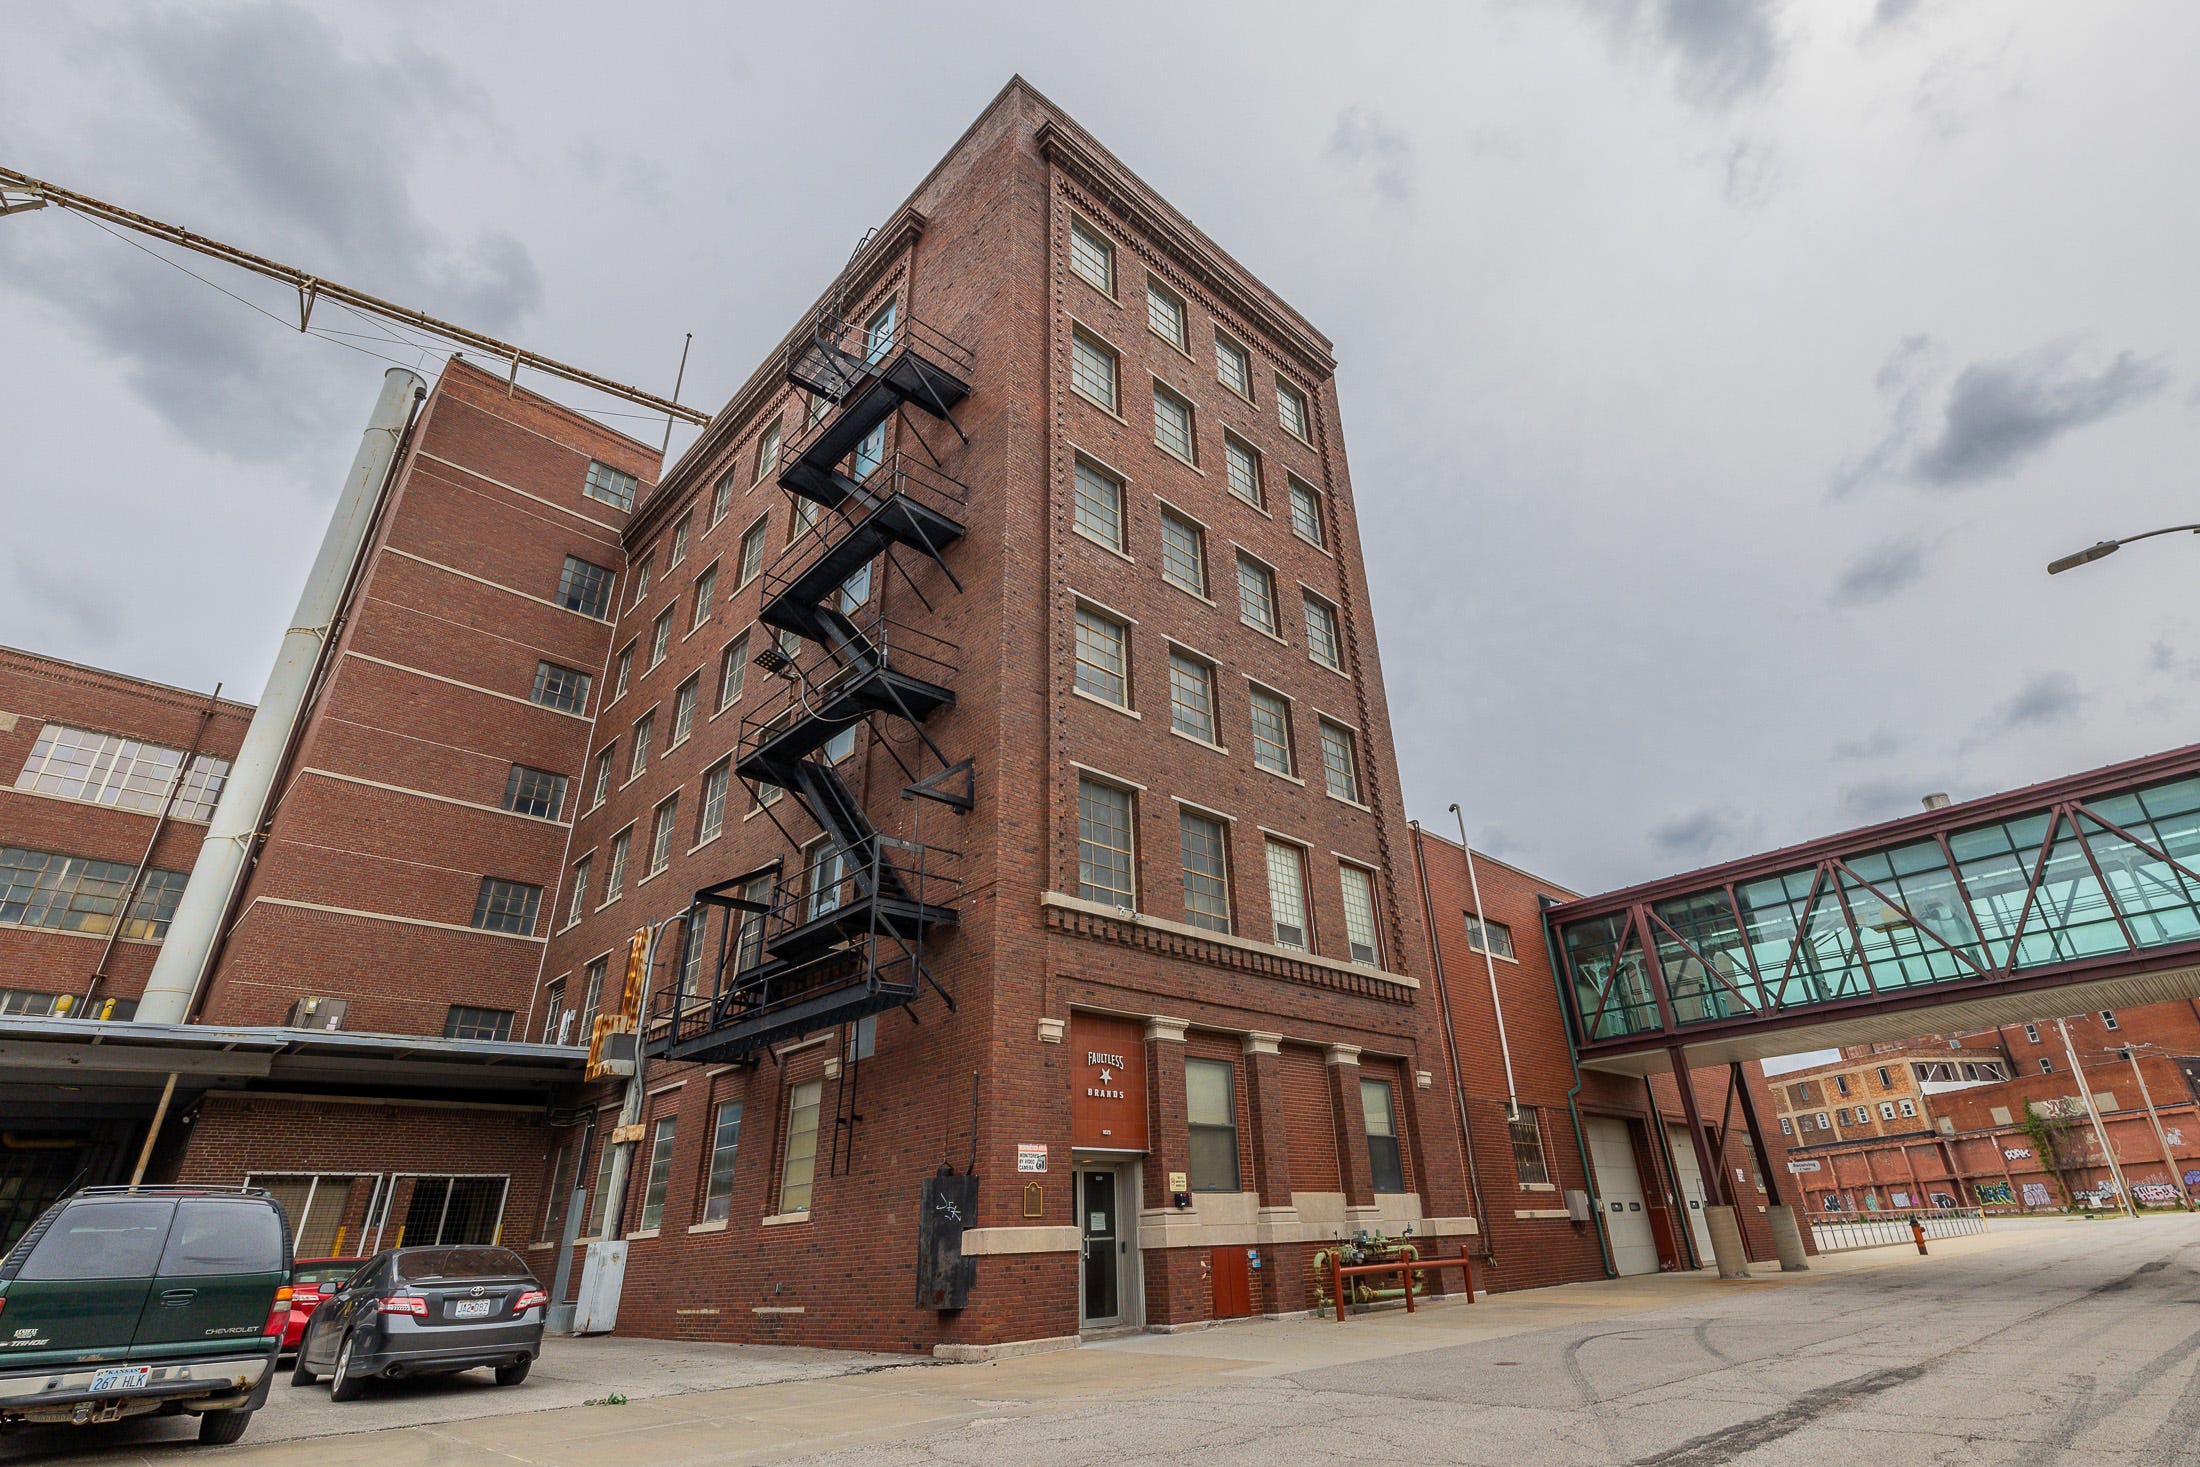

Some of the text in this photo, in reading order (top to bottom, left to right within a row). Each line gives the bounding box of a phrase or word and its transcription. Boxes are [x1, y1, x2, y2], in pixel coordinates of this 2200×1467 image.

[1088, 1051, 1124, 1070] FAULTLESS
[1087, 1088, 1124, 1099] BRANDS
[205, 1326, 260, 1335] CHEVROLET
[10, 1339, 50, 1347] TAHOE
[94, 1374, 146, 1391] 267 HLK
